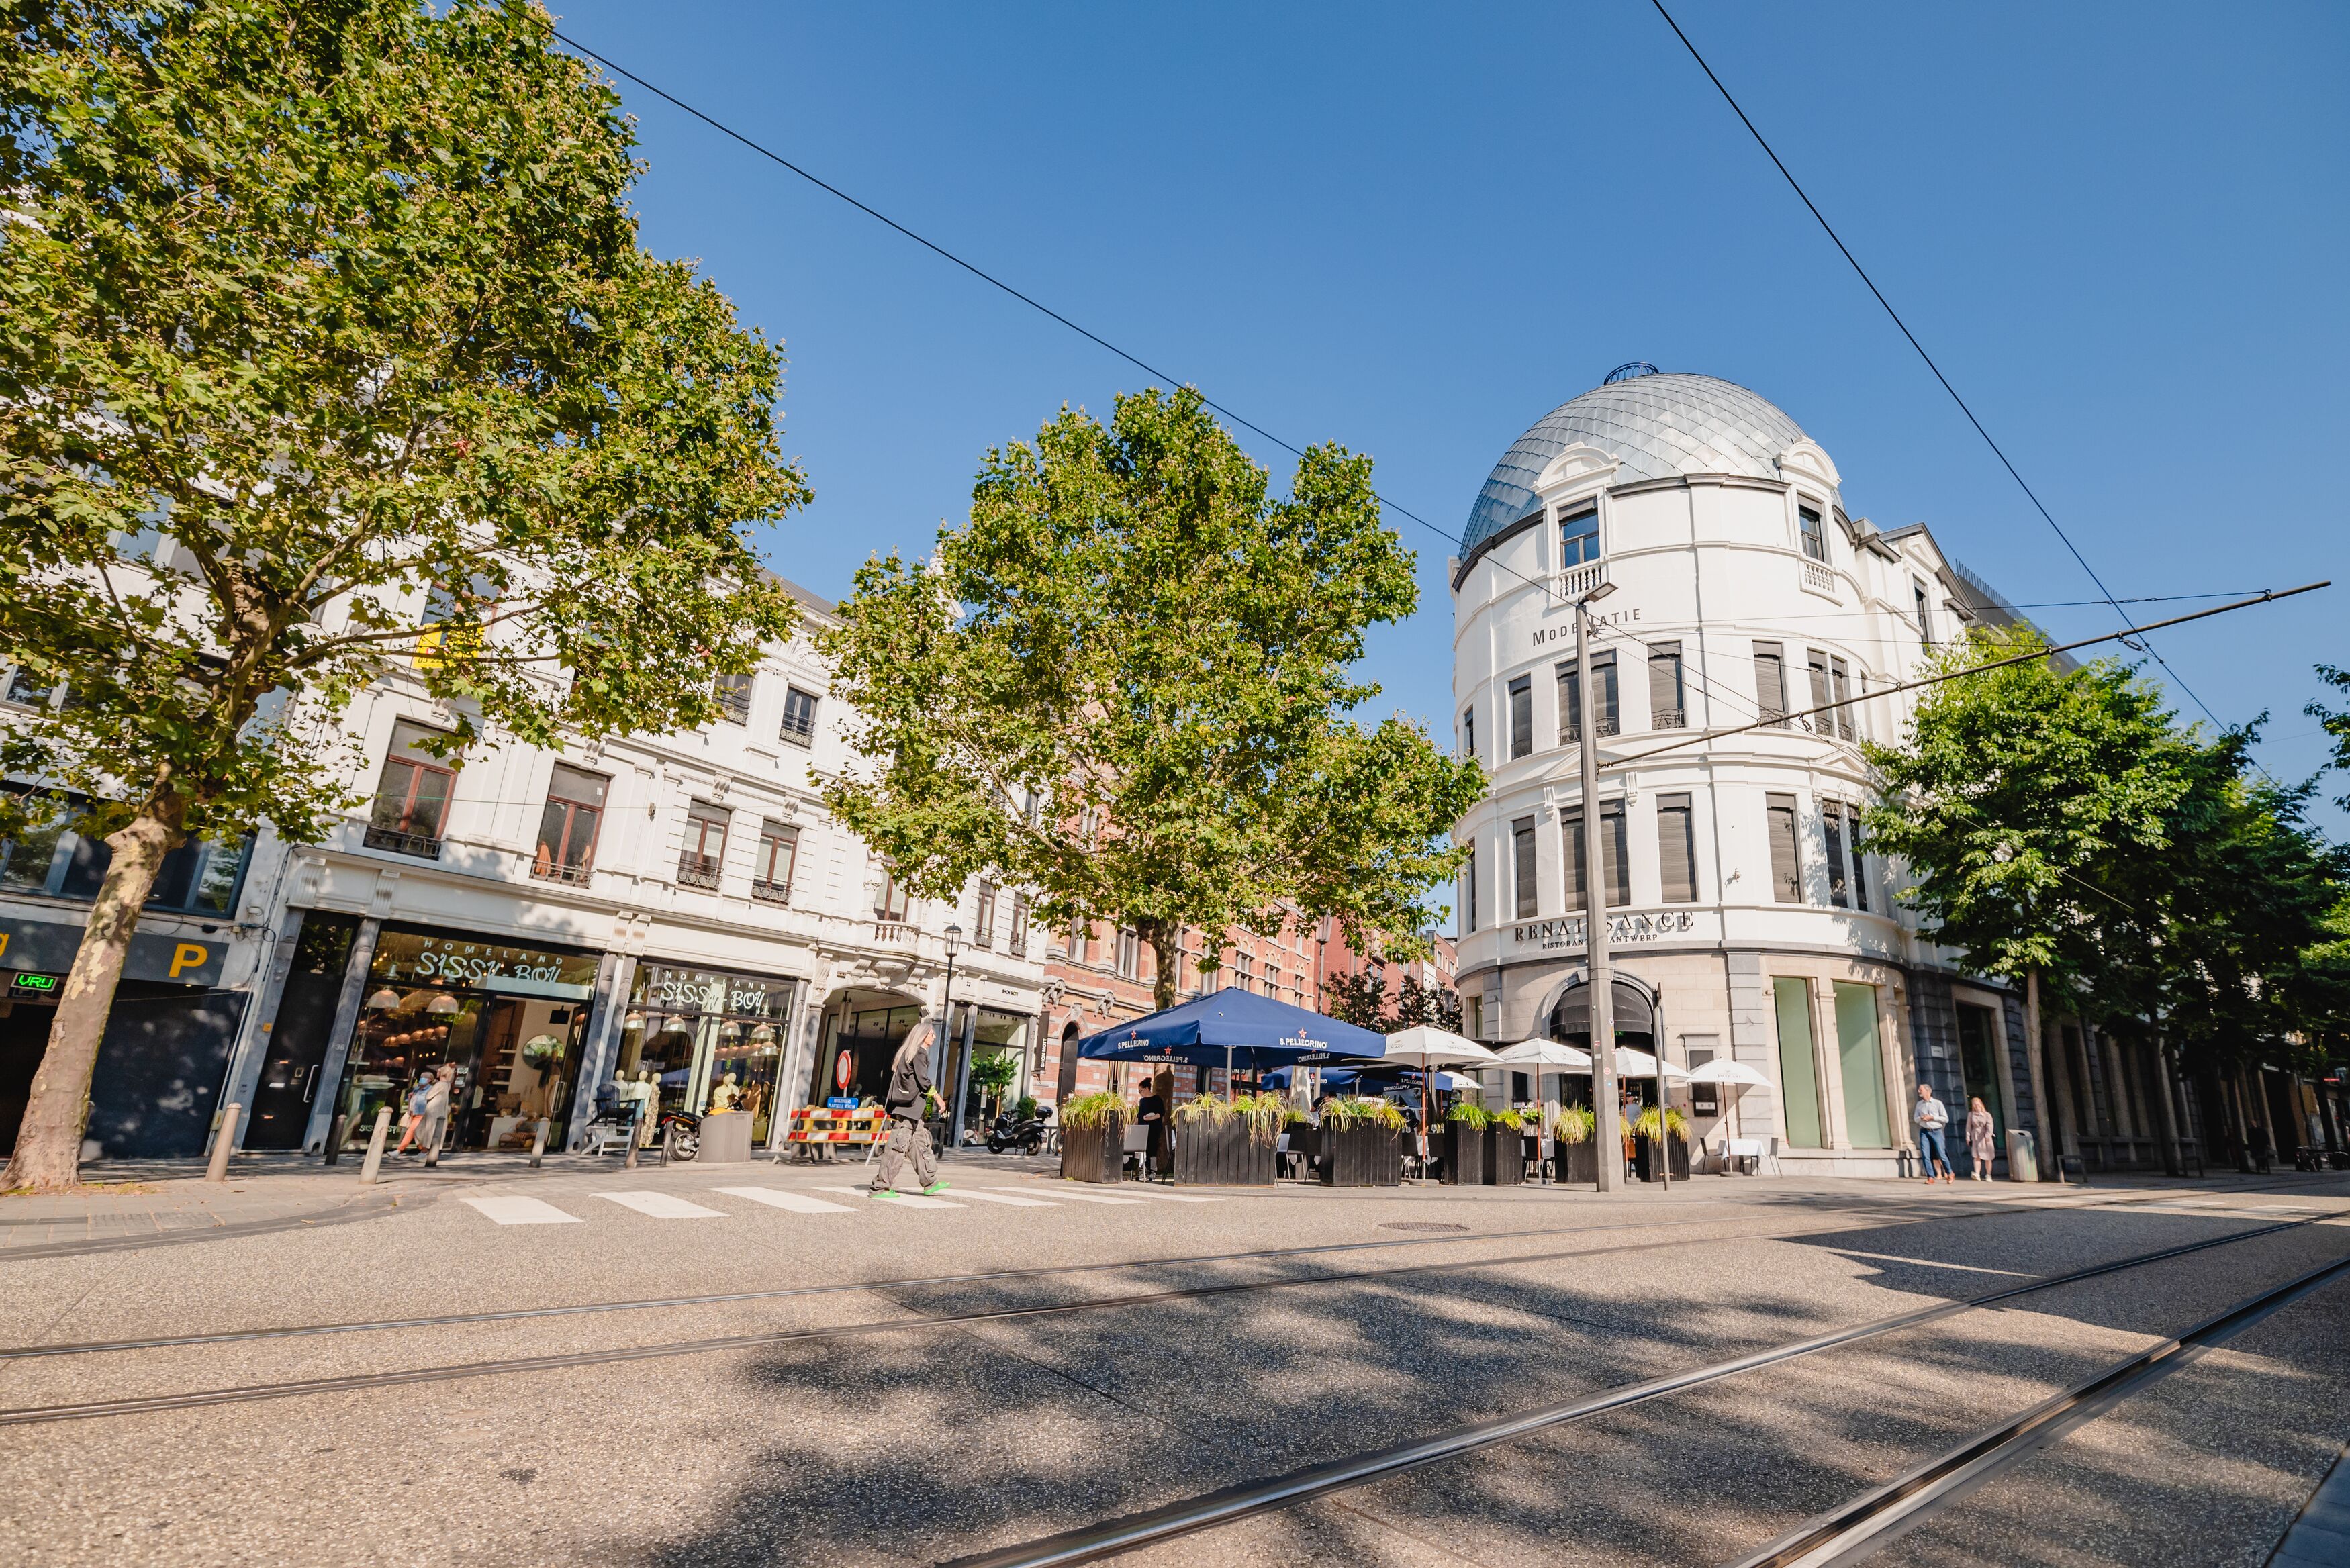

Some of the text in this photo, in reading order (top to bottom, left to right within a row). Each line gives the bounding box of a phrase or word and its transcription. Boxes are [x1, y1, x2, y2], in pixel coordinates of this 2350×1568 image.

[1515, 911, 1693, 941] RENAISANCE
[424, 940, 563, 965] HOMELAND
[1542, 934, 1658, 949] RISTORANT ANTWERP
[169, 943, 208, 977] P
[665, 971, 766, 990] HOMELAND
